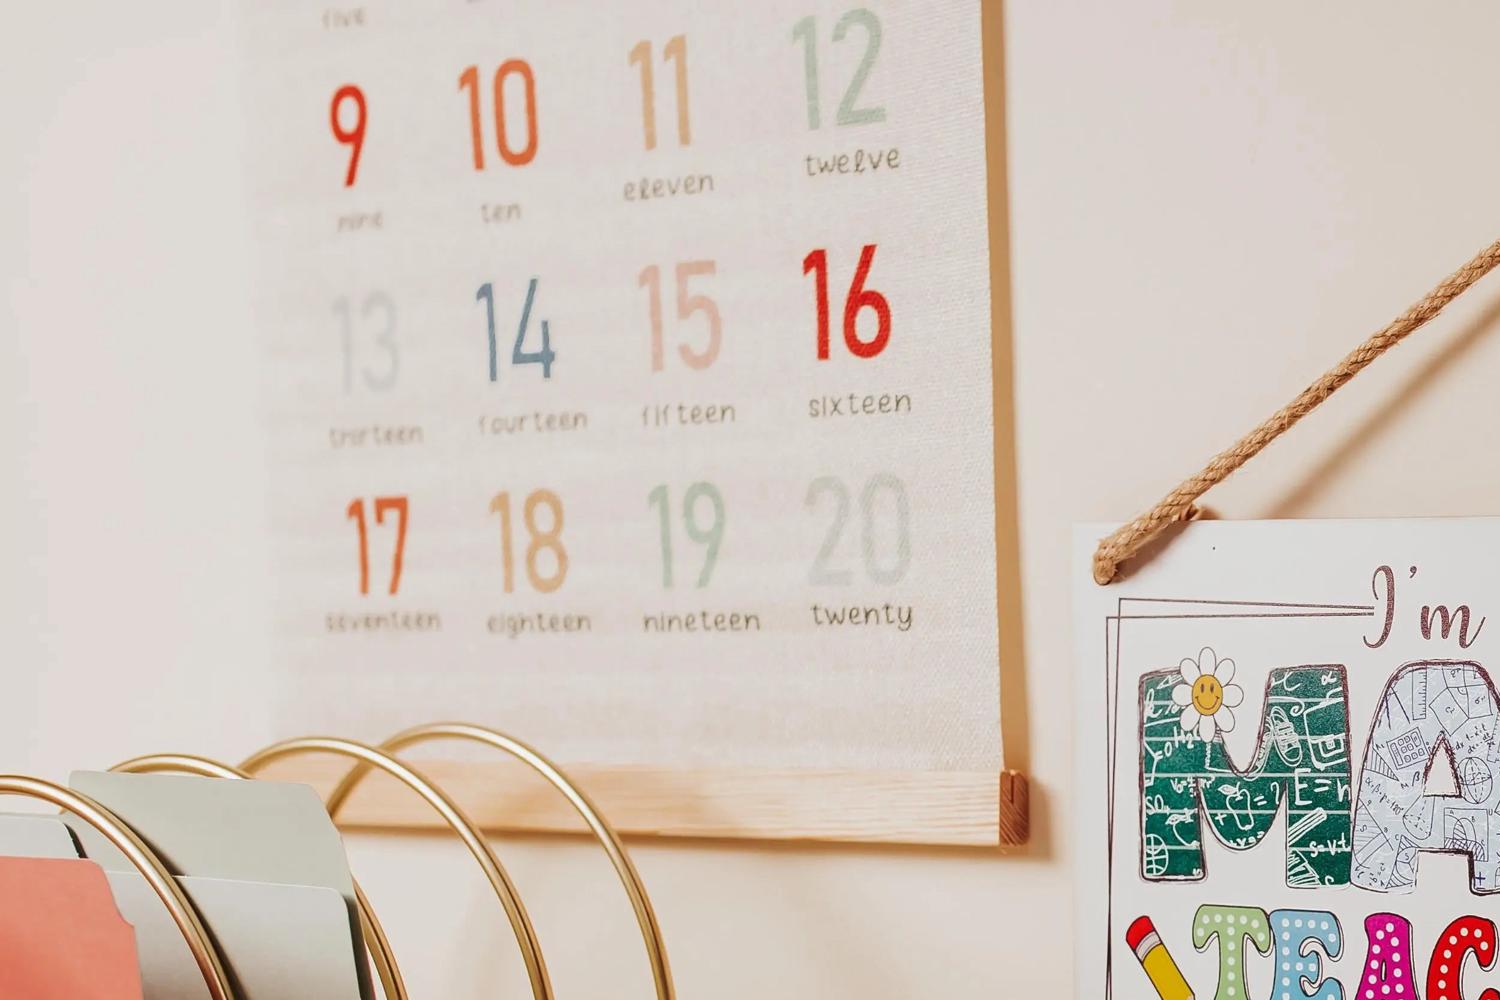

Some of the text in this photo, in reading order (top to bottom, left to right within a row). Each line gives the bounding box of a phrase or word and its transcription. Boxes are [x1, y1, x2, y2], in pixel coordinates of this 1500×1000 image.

[329, 8, 887, 188] 9 10 11 12
[480, 202, 522, 224] ten
[623, 173, 715, 202] eleven
[804, 148, 901, 177] twelve
[330, 243, 893, 395] 13 14 15 16
[479, 409, 589, 435] fourteen
[642, 403, 736, 427] fifteen
[807, 391, 913, 418] sixteen
[345, 471, 913, 596] 17 18 19 20
[486, 611, 592, 639] eighteen
[643, 610, 762, 632] nineteen
[811, 602, 913, 631] twenty
[1363, 564, 1487, 649] I'm
